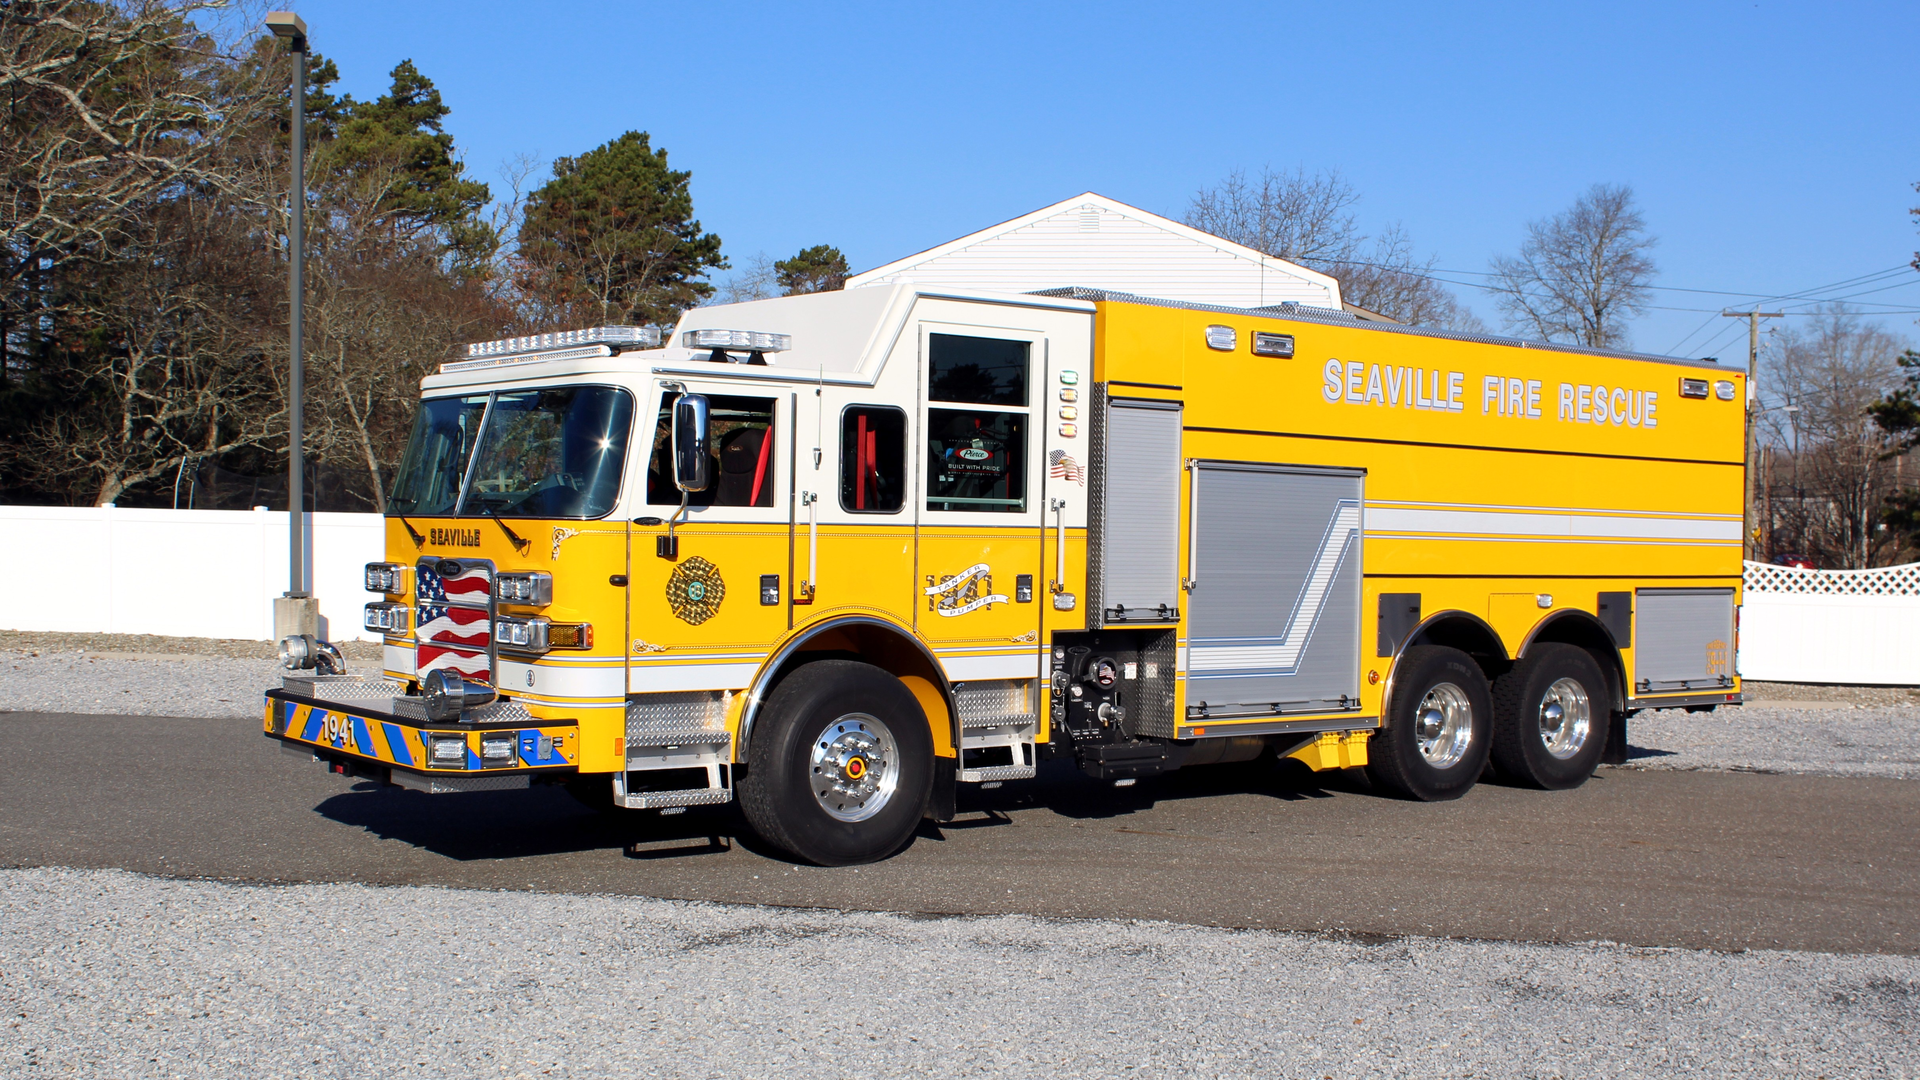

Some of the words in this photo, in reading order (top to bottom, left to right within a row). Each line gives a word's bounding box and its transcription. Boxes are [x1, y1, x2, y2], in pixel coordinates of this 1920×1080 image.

[1322, 358, 1465, 413] SEAVILLE
[1482, 375, 1543, 419] FIRE
[1558, 382, 1658, 428] RESCUE
[963, 449, 985, 458] Pierce
[430, 528, 480, 546] SEAVILLE
[937, 565, 981, 592] TANKER
[926, 574, 993, 612] 1941
[949, 595, 997, 616] PUMPER
[321, 714, 355, 747] 1941
